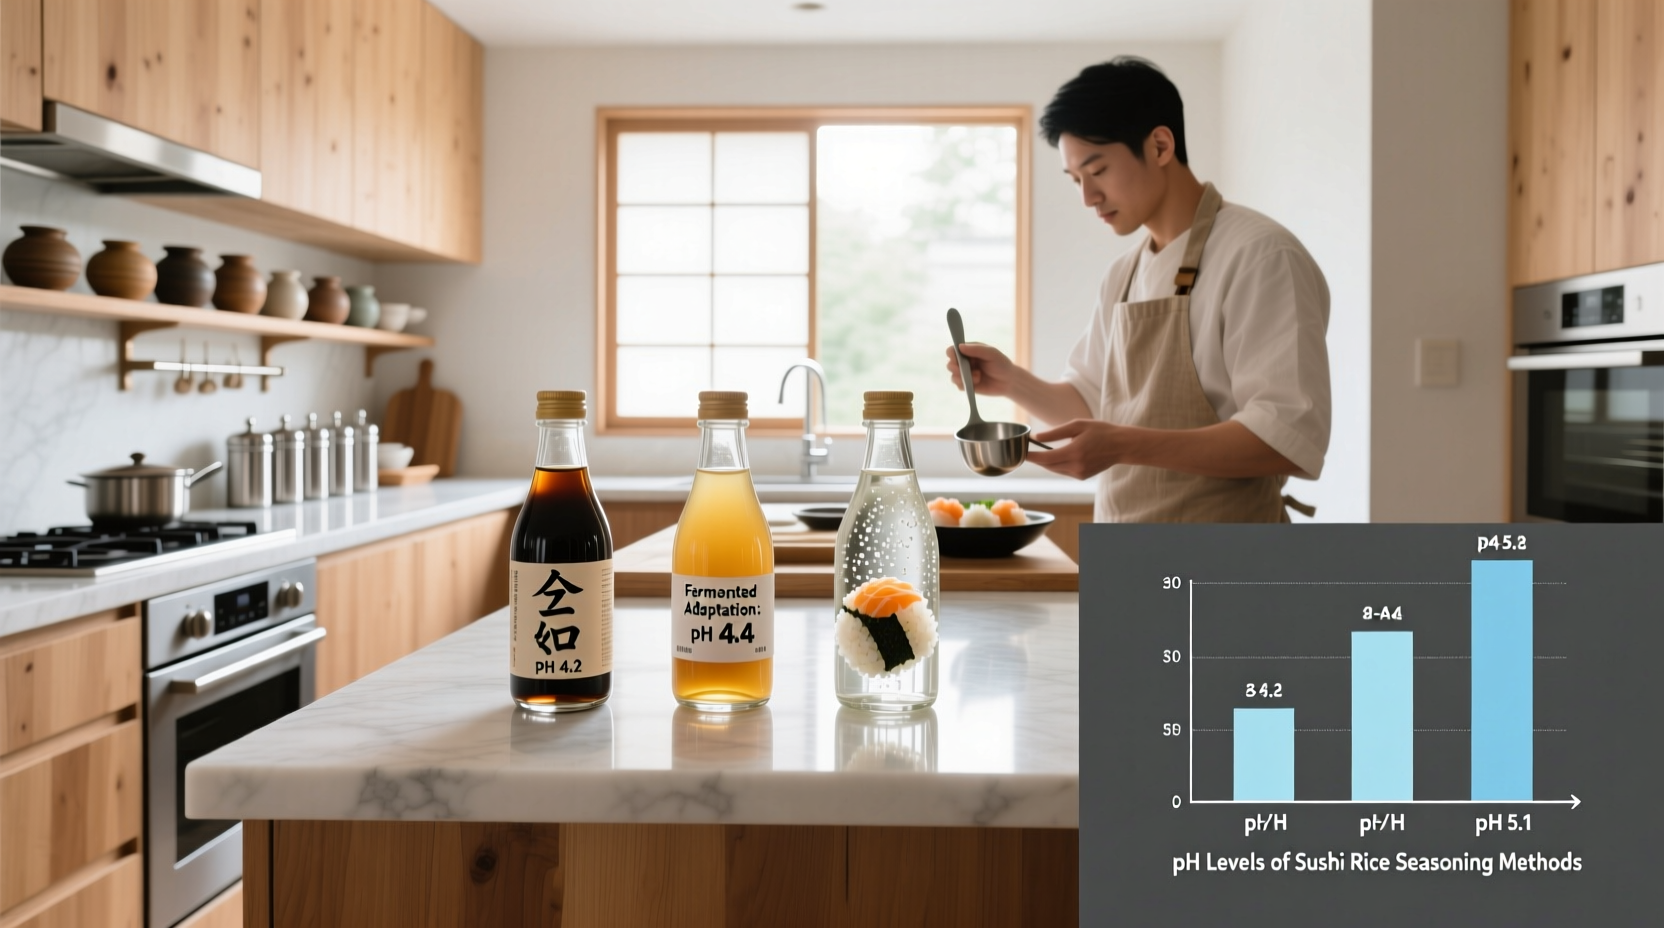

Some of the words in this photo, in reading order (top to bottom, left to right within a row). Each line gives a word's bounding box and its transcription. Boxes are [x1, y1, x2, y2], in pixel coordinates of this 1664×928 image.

[684, 583, 757, 599] Fermented
[690, 625, 713, 644] pH
[718, 622, 755, 644] 4.4
[559, 659, 582, 674] 4.2
